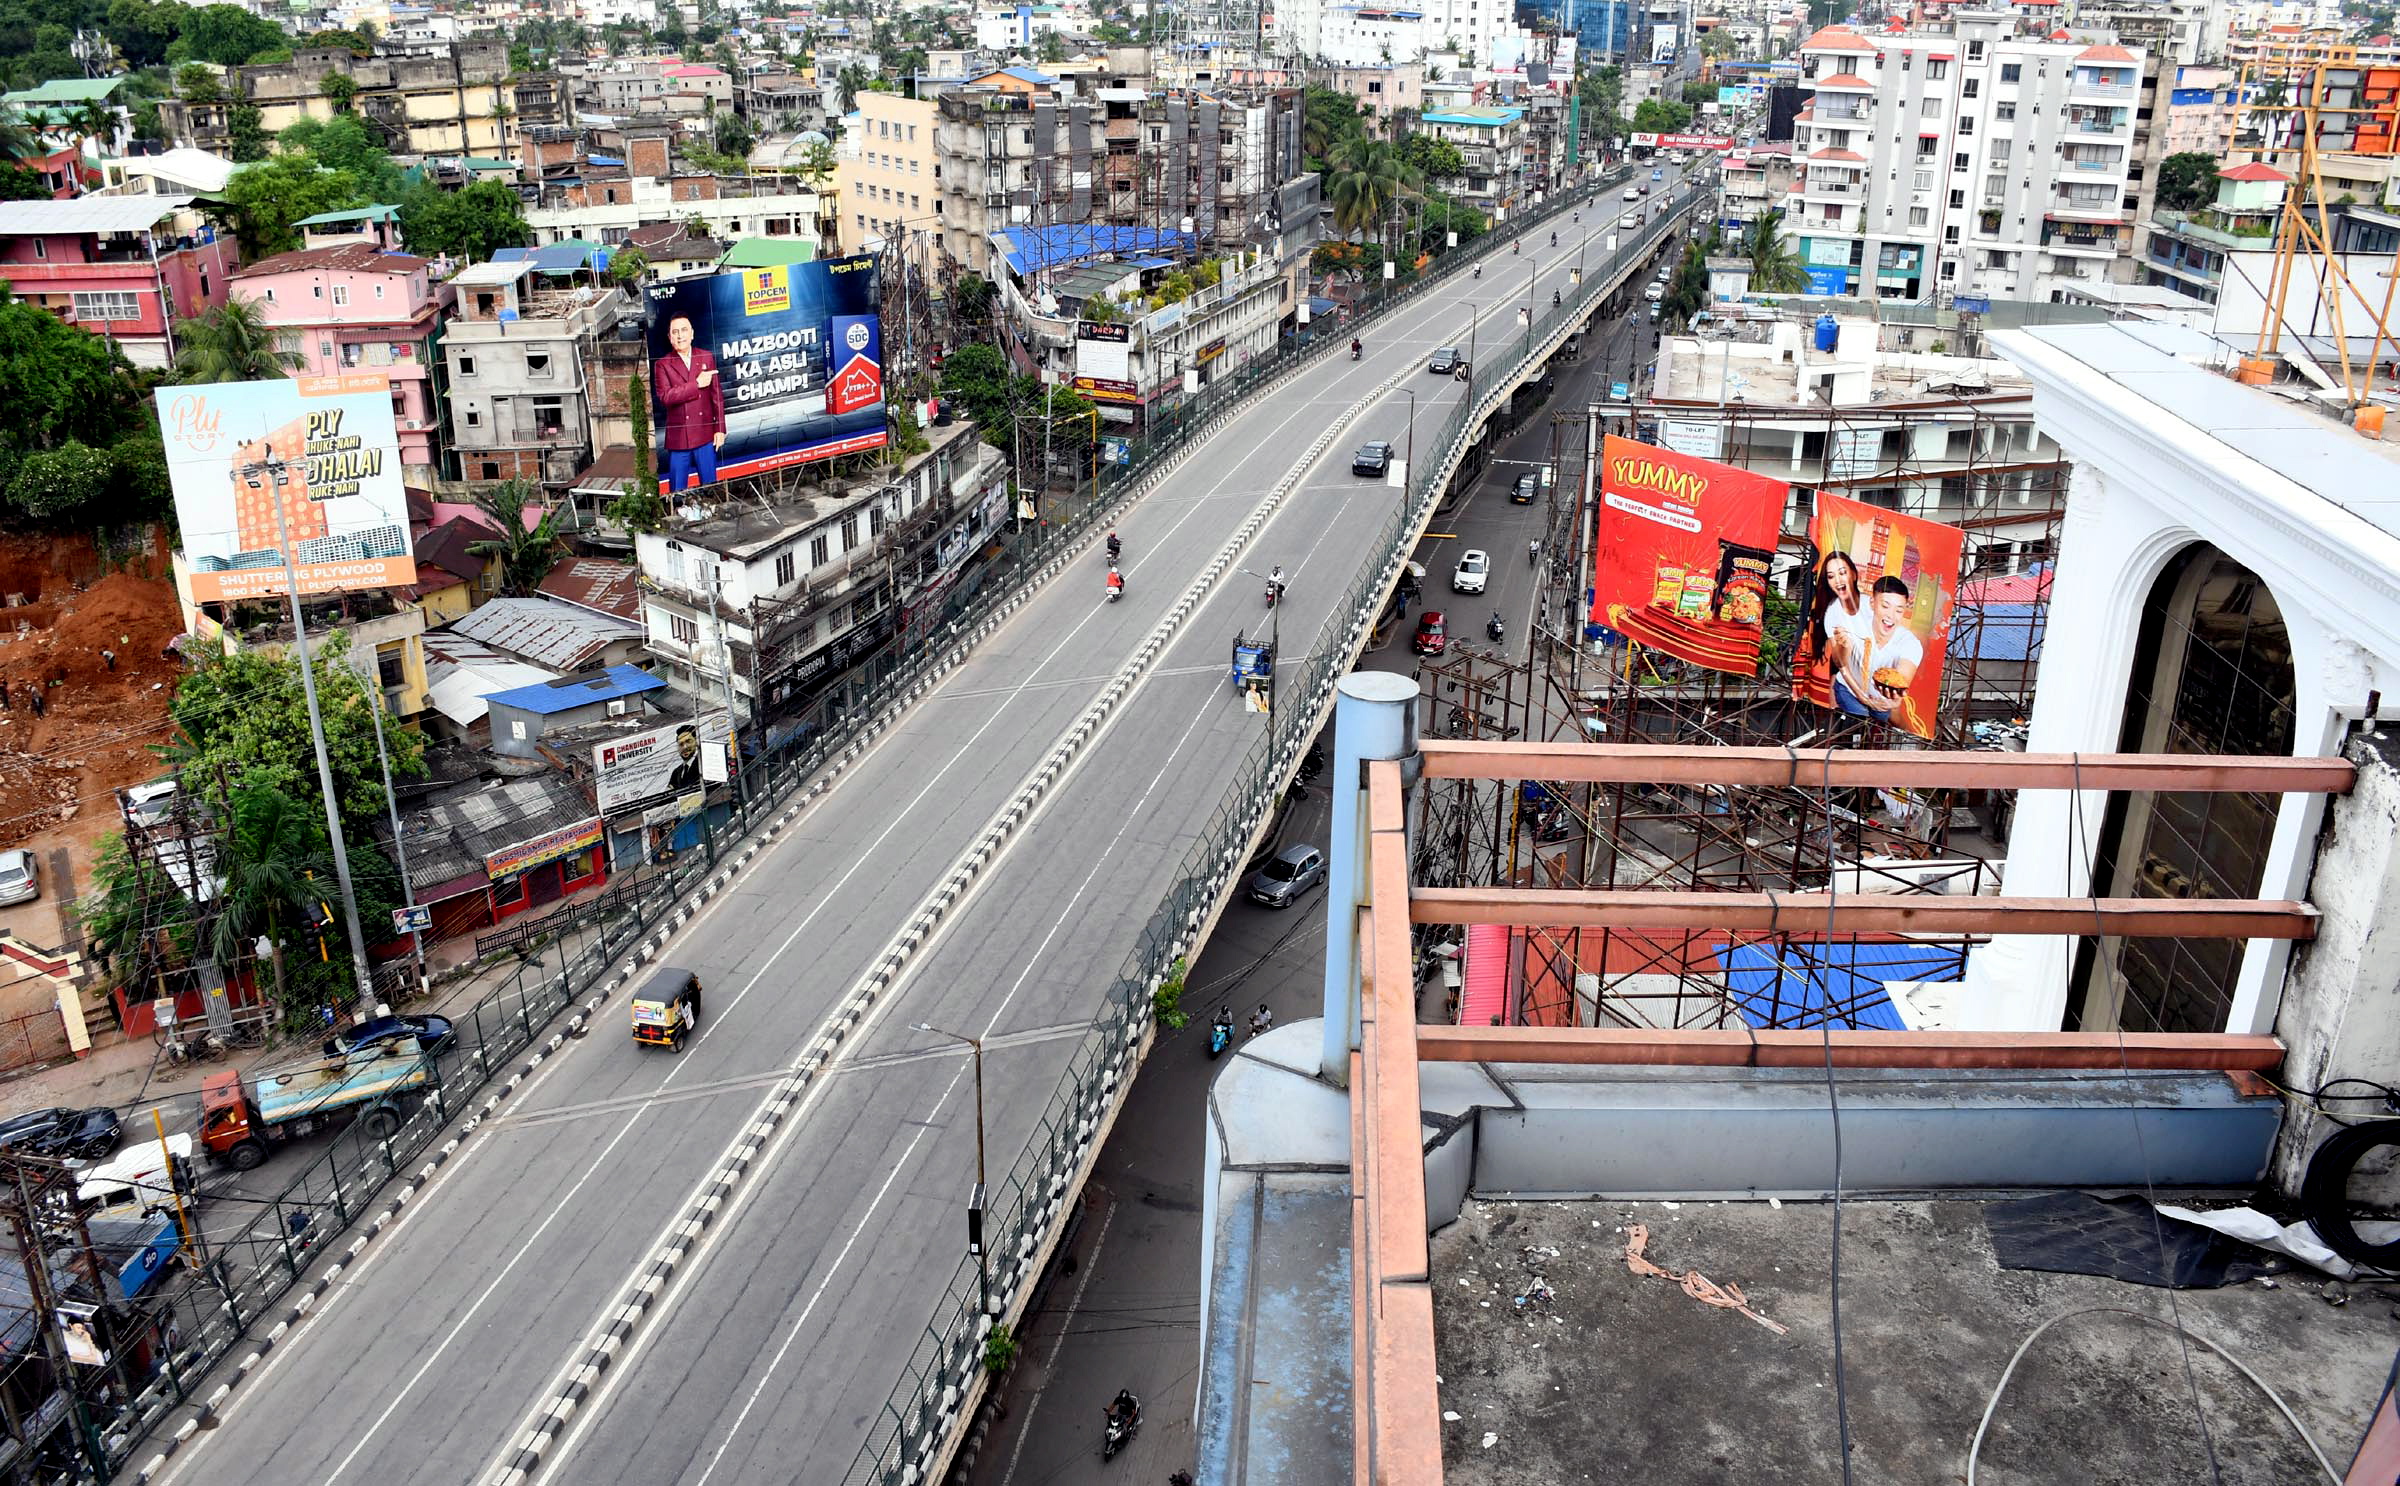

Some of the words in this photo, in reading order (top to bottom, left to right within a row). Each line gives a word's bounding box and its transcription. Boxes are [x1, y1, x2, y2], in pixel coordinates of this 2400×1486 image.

[1637, 134, 1653, 142] TAJ
[1663, 135, 1675, 143] THE
[1675, 136, 1702, 144] HONEST
[1702, 137, 1729, 145] CEMENT
[747, 286, 787, 300] TOPCEM
[848, 333, 868, 344] SDC
[1092, 324, 1125, 337] DARPAN
[722, 327, 817, 361] MAZBOOTI
[736, 360, 763, 380] KA
[768, 351, 808, 374] ASLI
[737, 373, 809, 401] CHAMP!
[170, 394, 223, 433] Ply
[306, 407, 344, 440] PLY
[306, 440, 335, 456] JHUKE
[336, 435, 361, 451] NAHI
[306, 448, 382, 485] DHALAI
[308, 485, 335, 501] RUKE
[335, 481, 360, 498] NAHI
[1613, 458, 1706, 504] YUMMY
[1613, 498, 1623, 507] THE
[1624, 502, 1648, 514] PERFECT
[1649, 510, 1667, 520] SNACK
[1669, 516, 1696, 528] PARTNER
[313, 562, 386, 578] PLYWOOD
[1733, 558, 1768, 572] YUMMY
[222, 588, 248, 597] 1800
[308, 575, 387, 590] PLYSTORY.COM
[616, 736, 657, 753] CHANDIGARH
[617, 746, 653, 761] UNIVERSITY
[549, 822, 598, 845] RESTAURANT
[144, 1251, 158, 1269] Jio
